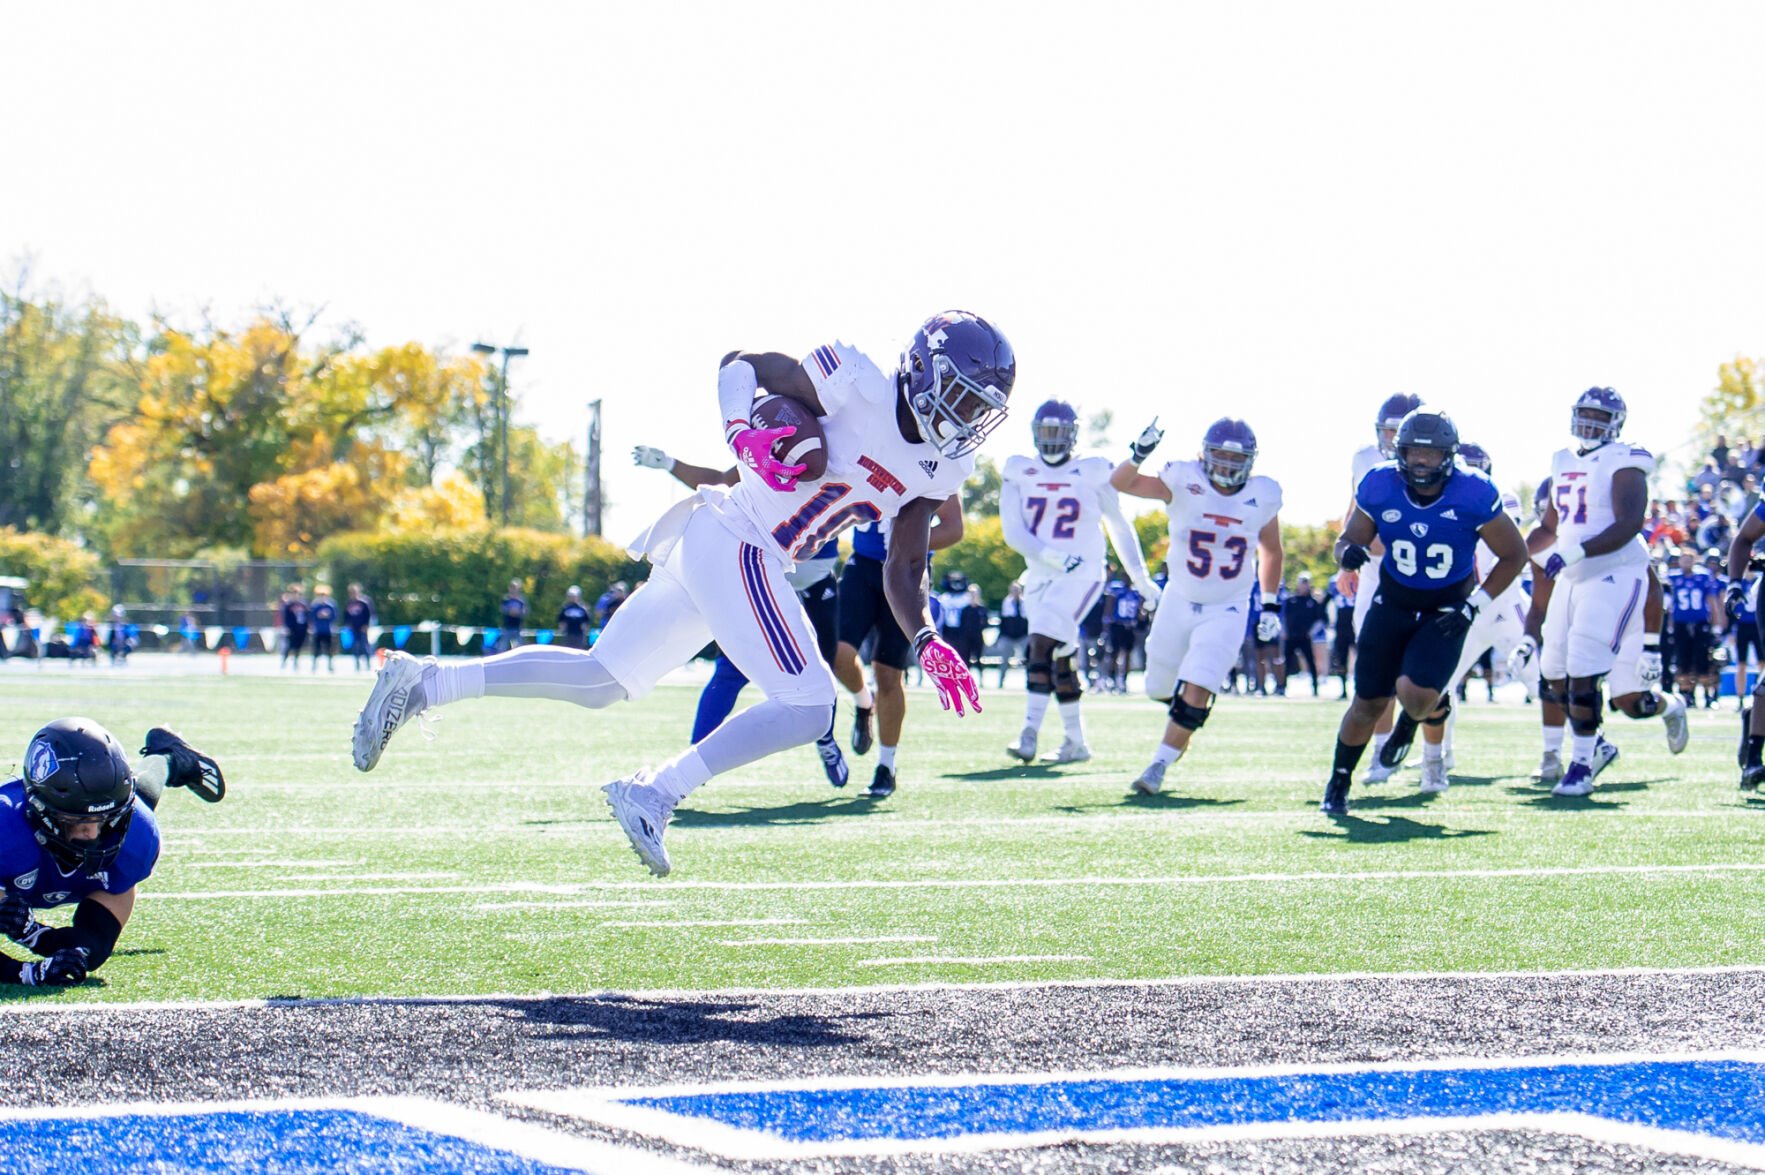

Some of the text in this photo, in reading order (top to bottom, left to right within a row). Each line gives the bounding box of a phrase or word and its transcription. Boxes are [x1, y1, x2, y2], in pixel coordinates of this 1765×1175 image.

[918, 460, 935, 480] adidas
[771, 482, 882, 561] 10
[1026, 496, 1081, 539] 72
[1556, 484, 1588, 525] 51
[1187, 530, 1247, 580] 53
[1391, 539, 1453, 579] 93
[88, 802, 116, 813] Riddell
